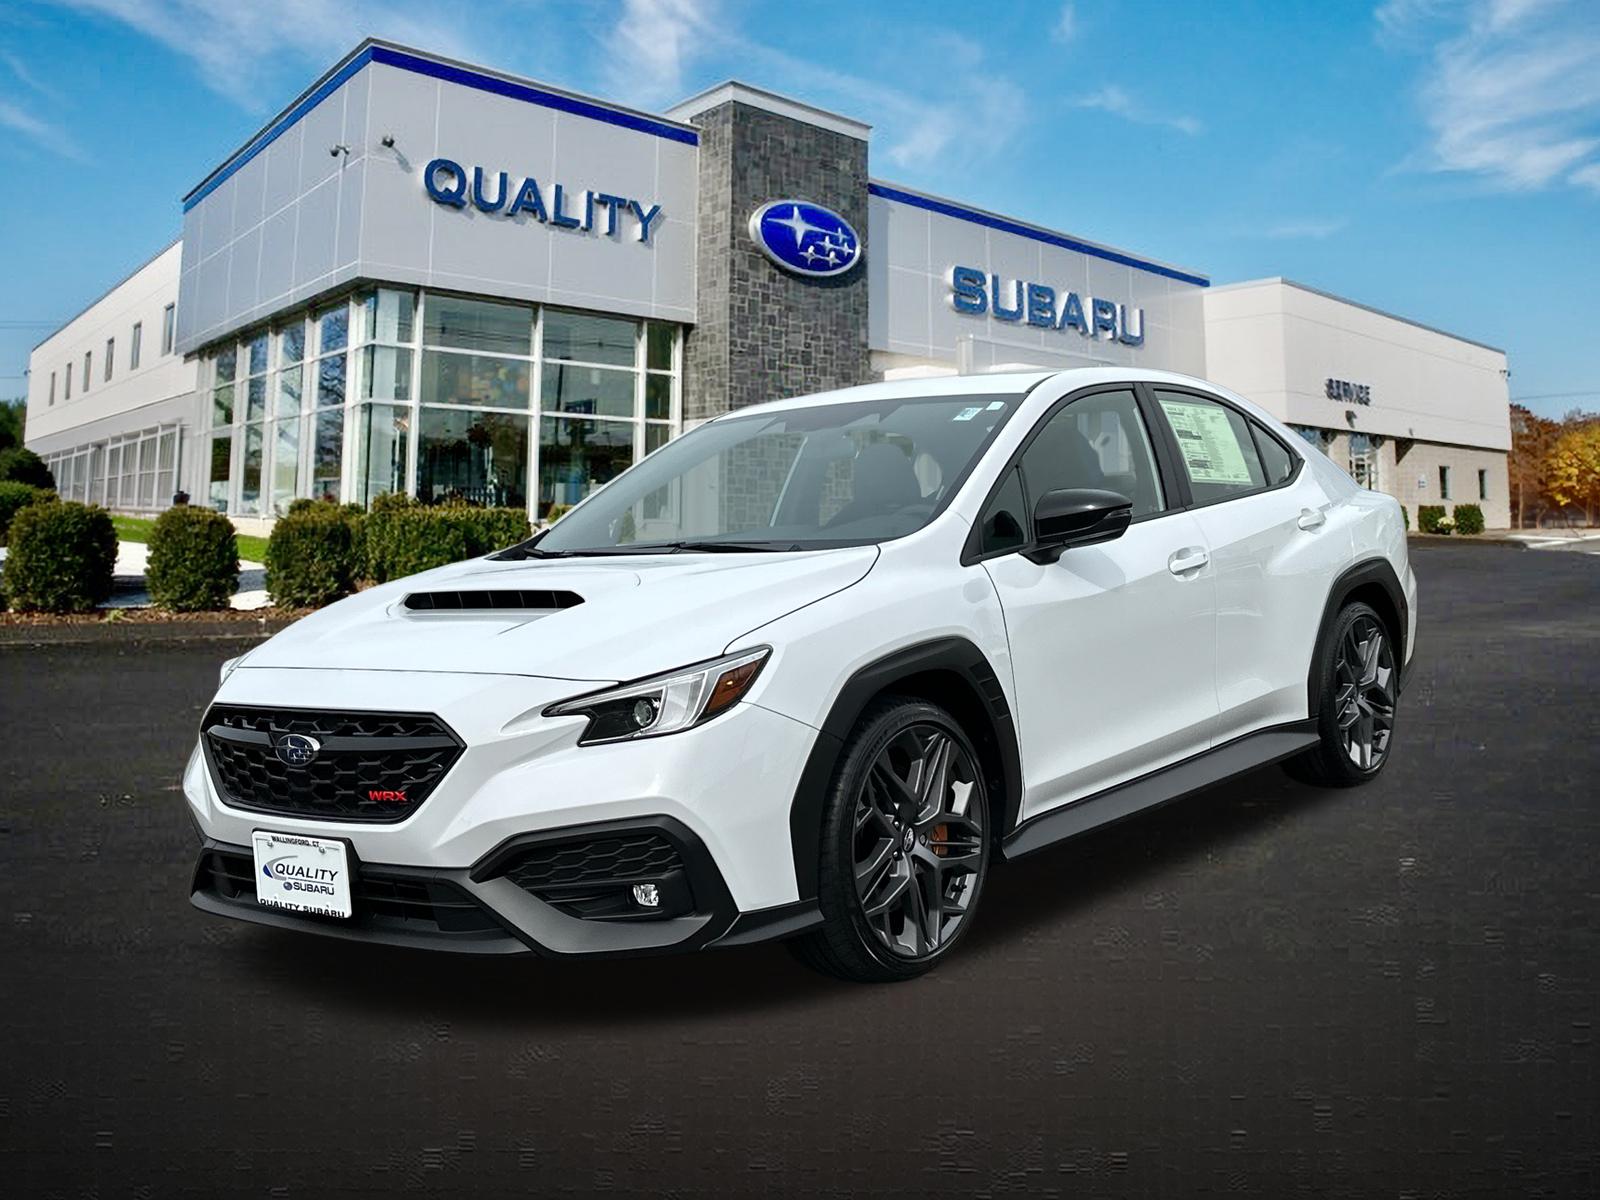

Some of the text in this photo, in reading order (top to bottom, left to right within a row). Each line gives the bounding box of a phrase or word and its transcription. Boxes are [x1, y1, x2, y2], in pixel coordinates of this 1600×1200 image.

[423, 157, 661, 243] QUALITY
[950, 265, 1145, 346] SUBARU
[368, 790, 408, 802] WRX
[275, 863, 339, 882] QUALITY
[293, 881, 335, 896] SUBARU
[260, 898, 345, 918] QUALITY SUBARU
